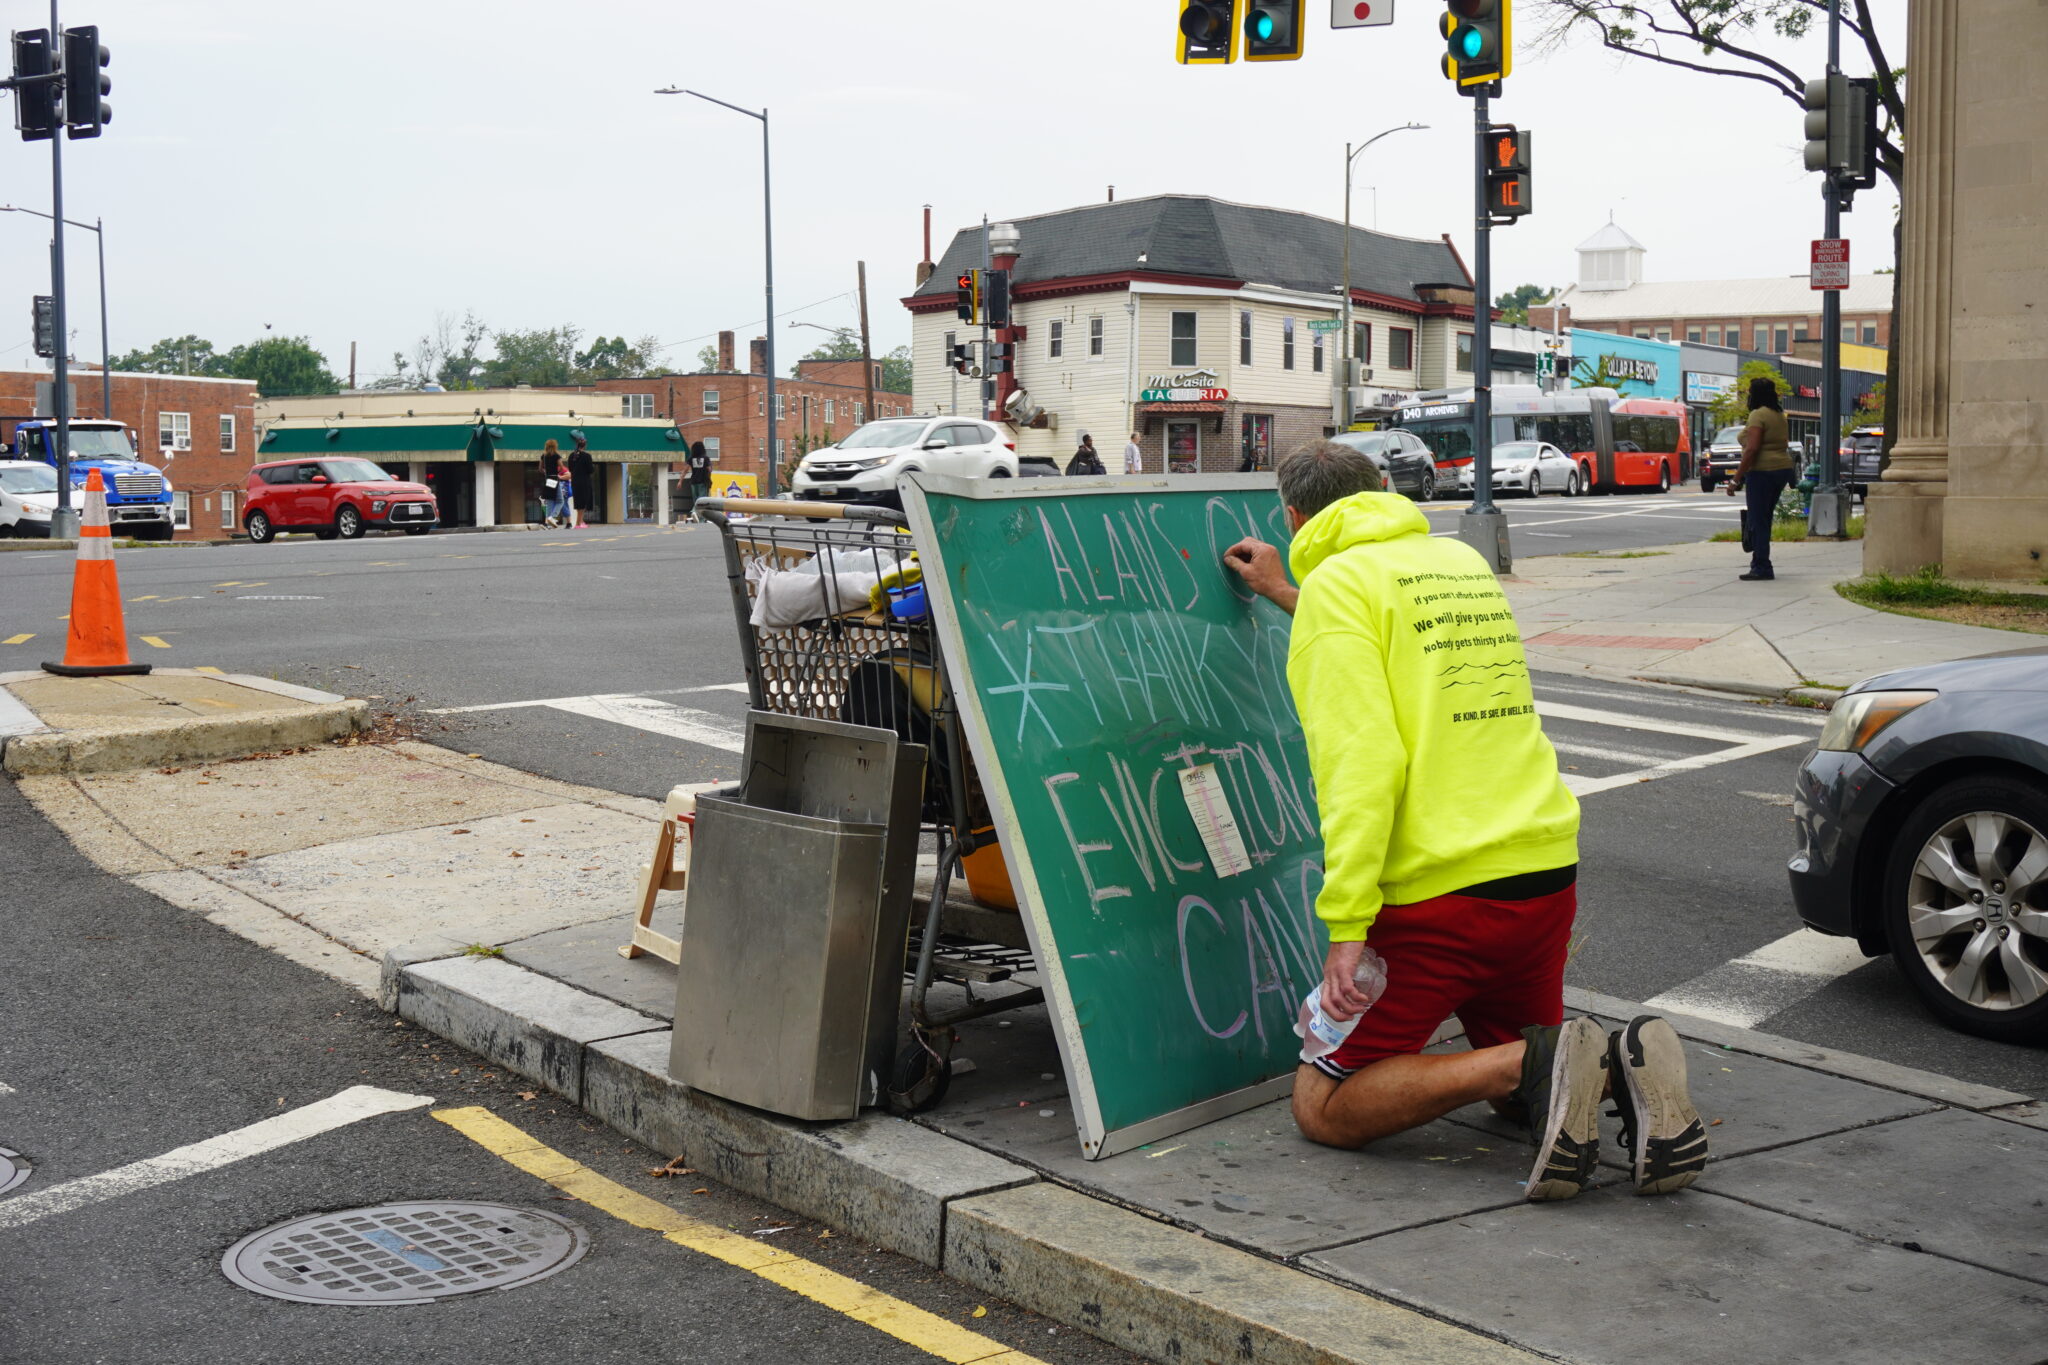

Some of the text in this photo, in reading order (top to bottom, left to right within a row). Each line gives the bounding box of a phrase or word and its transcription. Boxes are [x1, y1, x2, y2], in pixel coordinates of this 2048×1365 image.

[1814, 247, 1846, 255] EMERGENCY
[1819, 240, 1842, 249] SNOW
[1817, 253, 1843, 262] ROUTE
[1823, 262, 1847, 270] PARKING
[1813, 277, 1846, 285] EMERGENCY
[1635, 360, 1659, 381] BEYOND
[1147, 389, 1225, 400] TAQUERIA
[1403, 404, 1459, 419] D40 ARCHIVES
[1036, 498, 1199, 612] ALAN'S
[1397, 577, 1414, 588] The
[1415, 572, 1434, 584] price
[1434, 572, 1446, 581] you
[1414, 595, 1421, 606] If
[1422, 592, 1438, 605] you
[1439, 591, 1455, 600] can't
[1455, 591, 1473, 600] afford
[1413, 619, 1434, 634] We
[1434, 611, 1454, 625] will
[1455, 611, 1472, 626] give
[1473, 613, 1490, 626] you
[1490, 611, 1504, 621] one
[1423, 637, 1454, 655] Nobody
[1455, 638, 1472, 651] gets
[1473, 635, 1497, 647] thirsty
[1498, 634, 1506, 643] at
[1035, 607, 1248, 732] THANK
[1453, 713, 1461, 722] BE
[1480, 710, 1487, 719] BE
[1500, 707, 1507, 717] BE
[1523, 704, 1528, 714] BE
[1041, 741, 1317, 914] EVICTION
